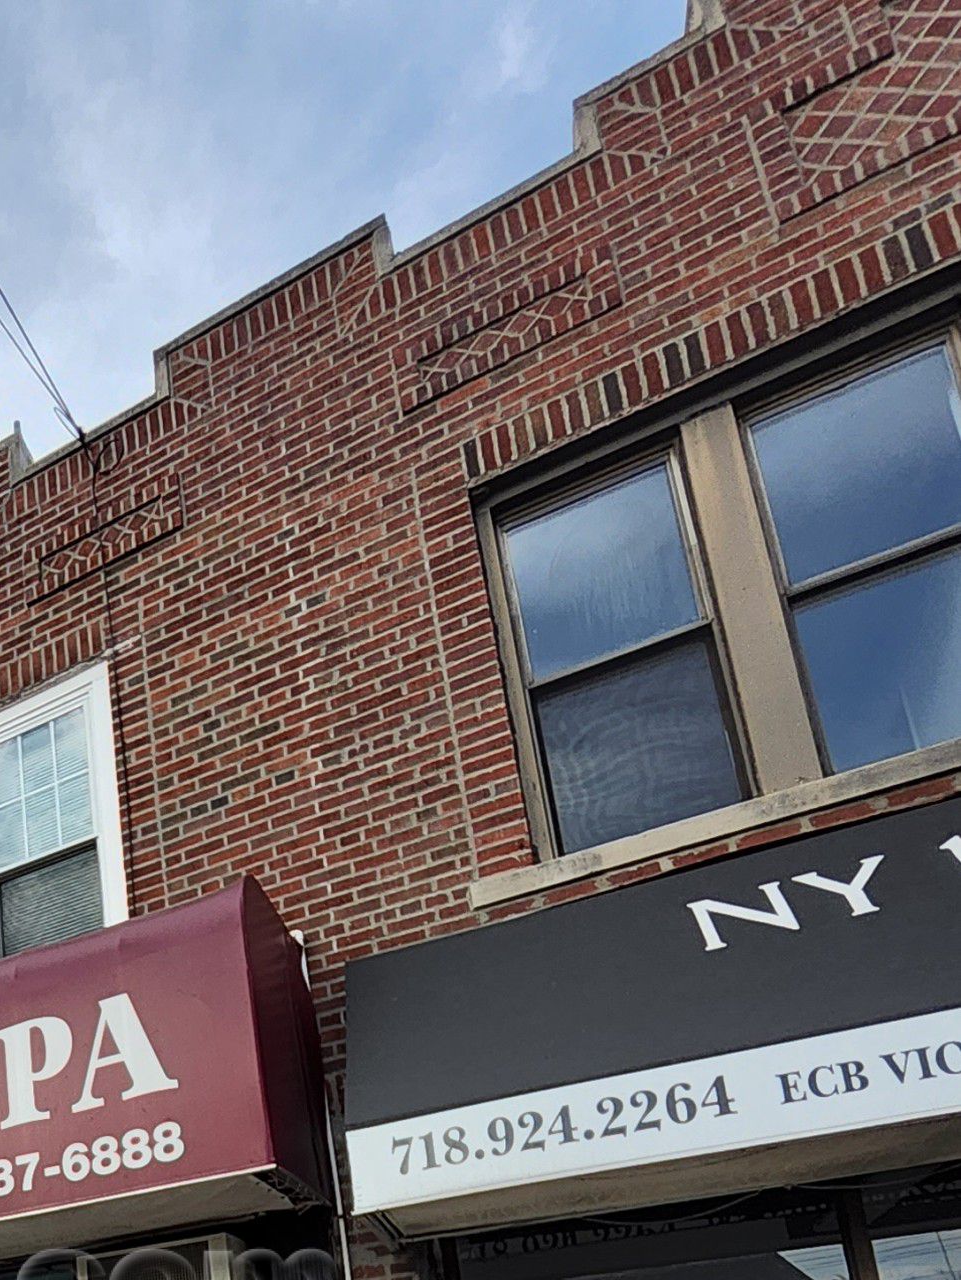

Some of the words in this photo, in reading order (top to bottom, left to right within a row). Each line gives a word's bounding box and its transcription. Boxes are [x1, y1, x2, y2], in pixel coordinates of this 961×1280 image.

[687, 854, 885, 951] NY
[392, 1075, 738, 1175] 718.924.2264
[775, 1060, 870, 1105] ECB
